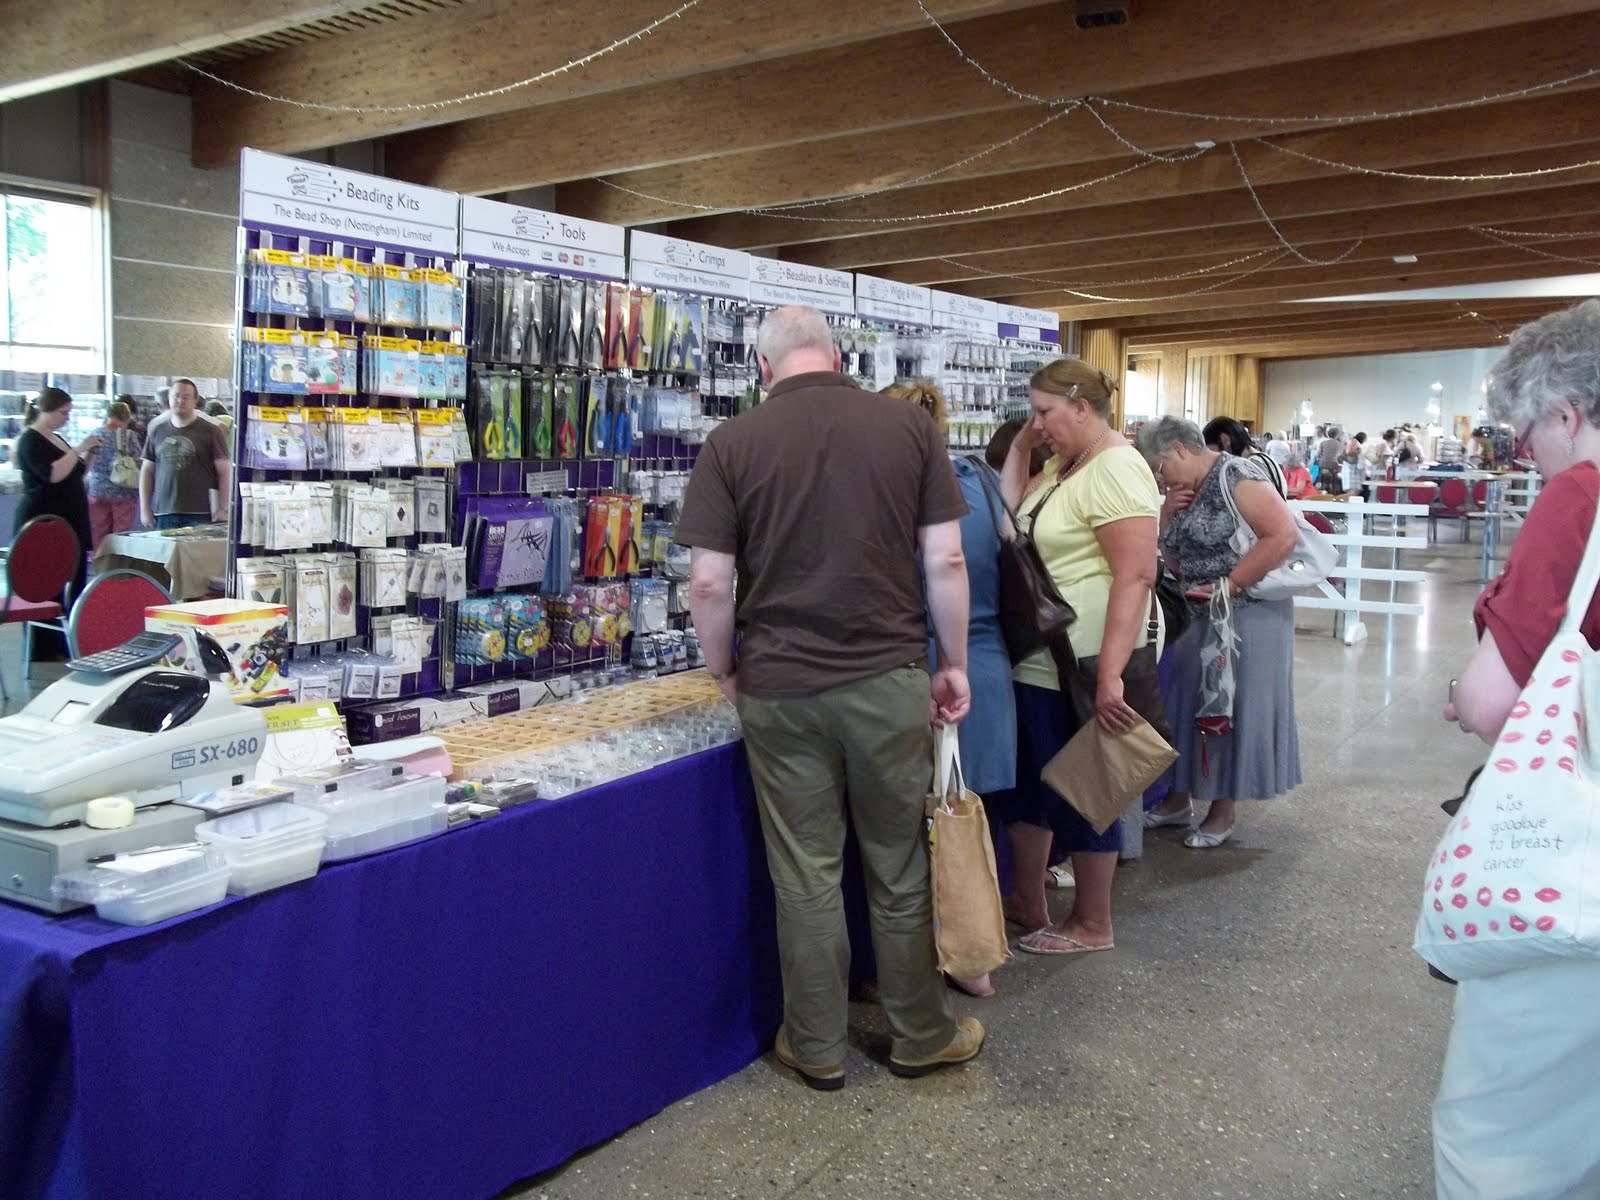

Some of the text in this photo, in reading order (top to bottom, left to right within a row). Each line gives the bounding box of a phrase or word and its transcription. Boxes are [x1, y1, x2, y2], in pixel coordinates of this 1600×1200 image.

[346, 182, 420, 211] Beading Kits
[273, 203, 433, 242] The Bead Shop (Nottingham) Limited
[560, 222, 587, 241] Tools
[491, 240, 531, 257] We Accept
[698, 250, 726, 270] Crimps
[654, 268, 678, 283] Crimping
[785, 268, 817, 284] Beadalon
[818, 273, 823, 285] &
[200, 737, 258, 764] SX-680
[1490, 817, 1548, 835] goodbye
[1488, 834, 1564, 851] to breast
[1483, 856, 1530, 871] cancer
